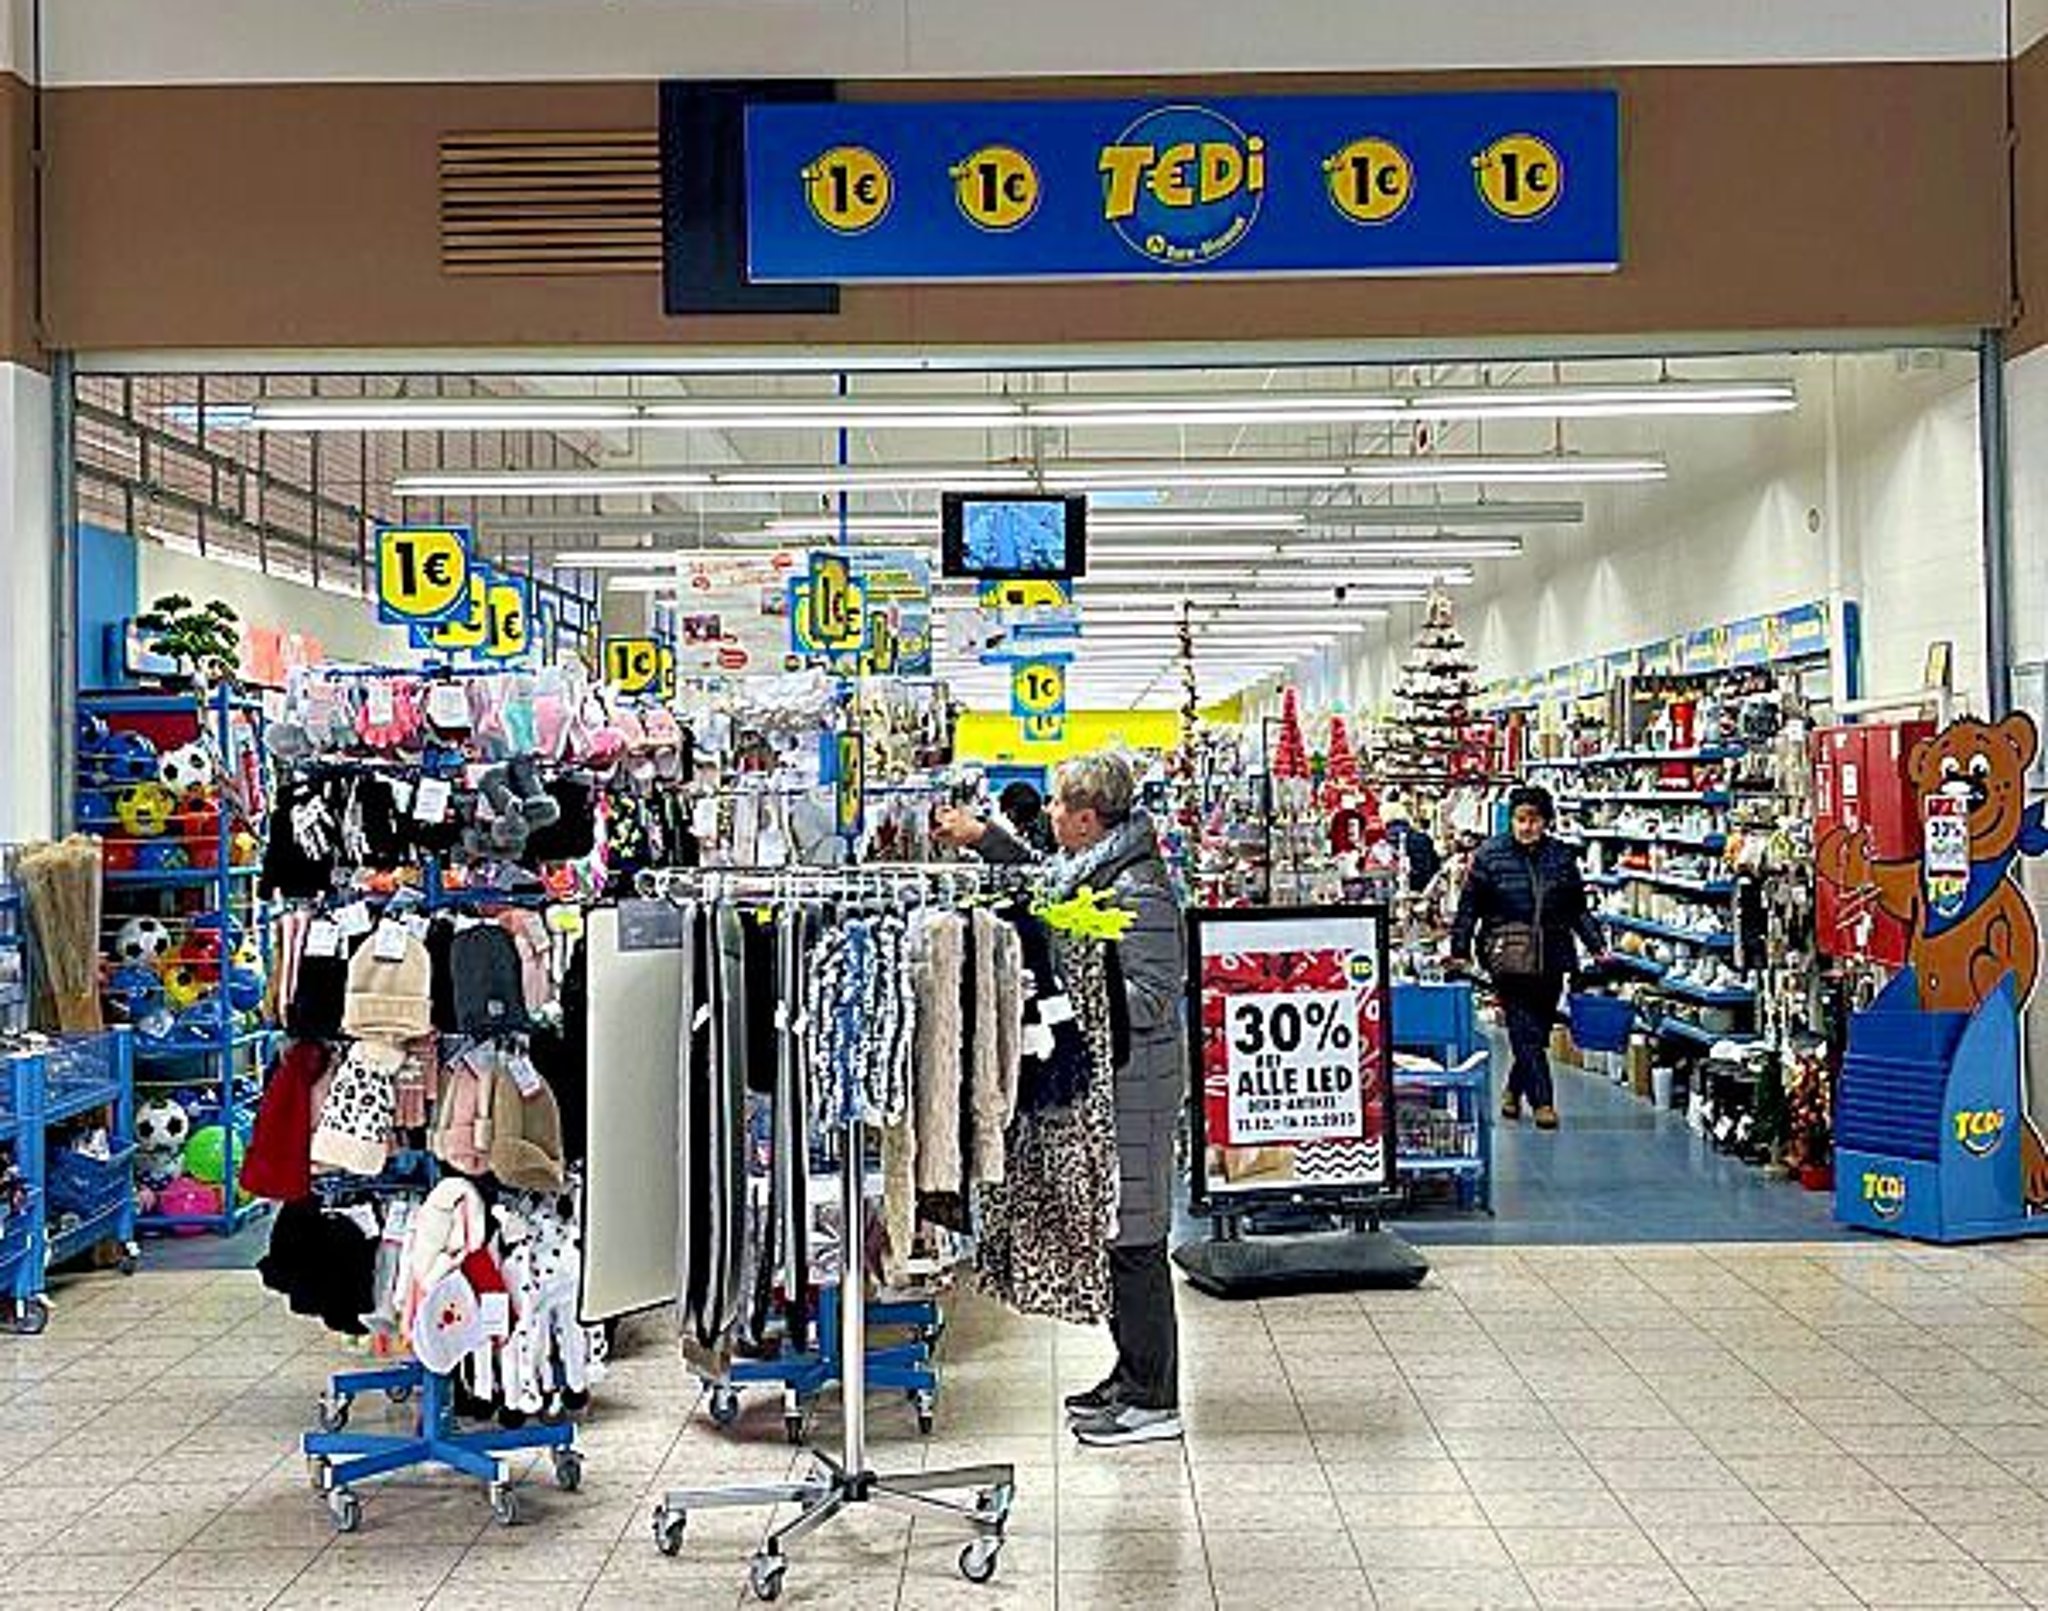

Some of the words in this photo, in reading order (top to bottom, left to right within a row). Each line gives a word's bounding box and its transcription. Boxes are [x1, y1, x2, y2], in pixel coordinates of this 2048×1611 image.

[831, 165, 878, 213] 1€
[978, 163, 1027, 212] 1€
[1351, 156, 1400, 205] 1€
[1501, 153, 1549, 202] 1€
[395, 541, 452, 596] 1€
[488, 604, 522, 646] 1€
[615, 645, 651, 679] 1€
[1026, 673, 1054, 701] 1€
[1234, 999, 1353, 1055] 30%
[1236, 1067, 1299, 1097] ALLE
[1306, 1064, 1353, 1093] LED
